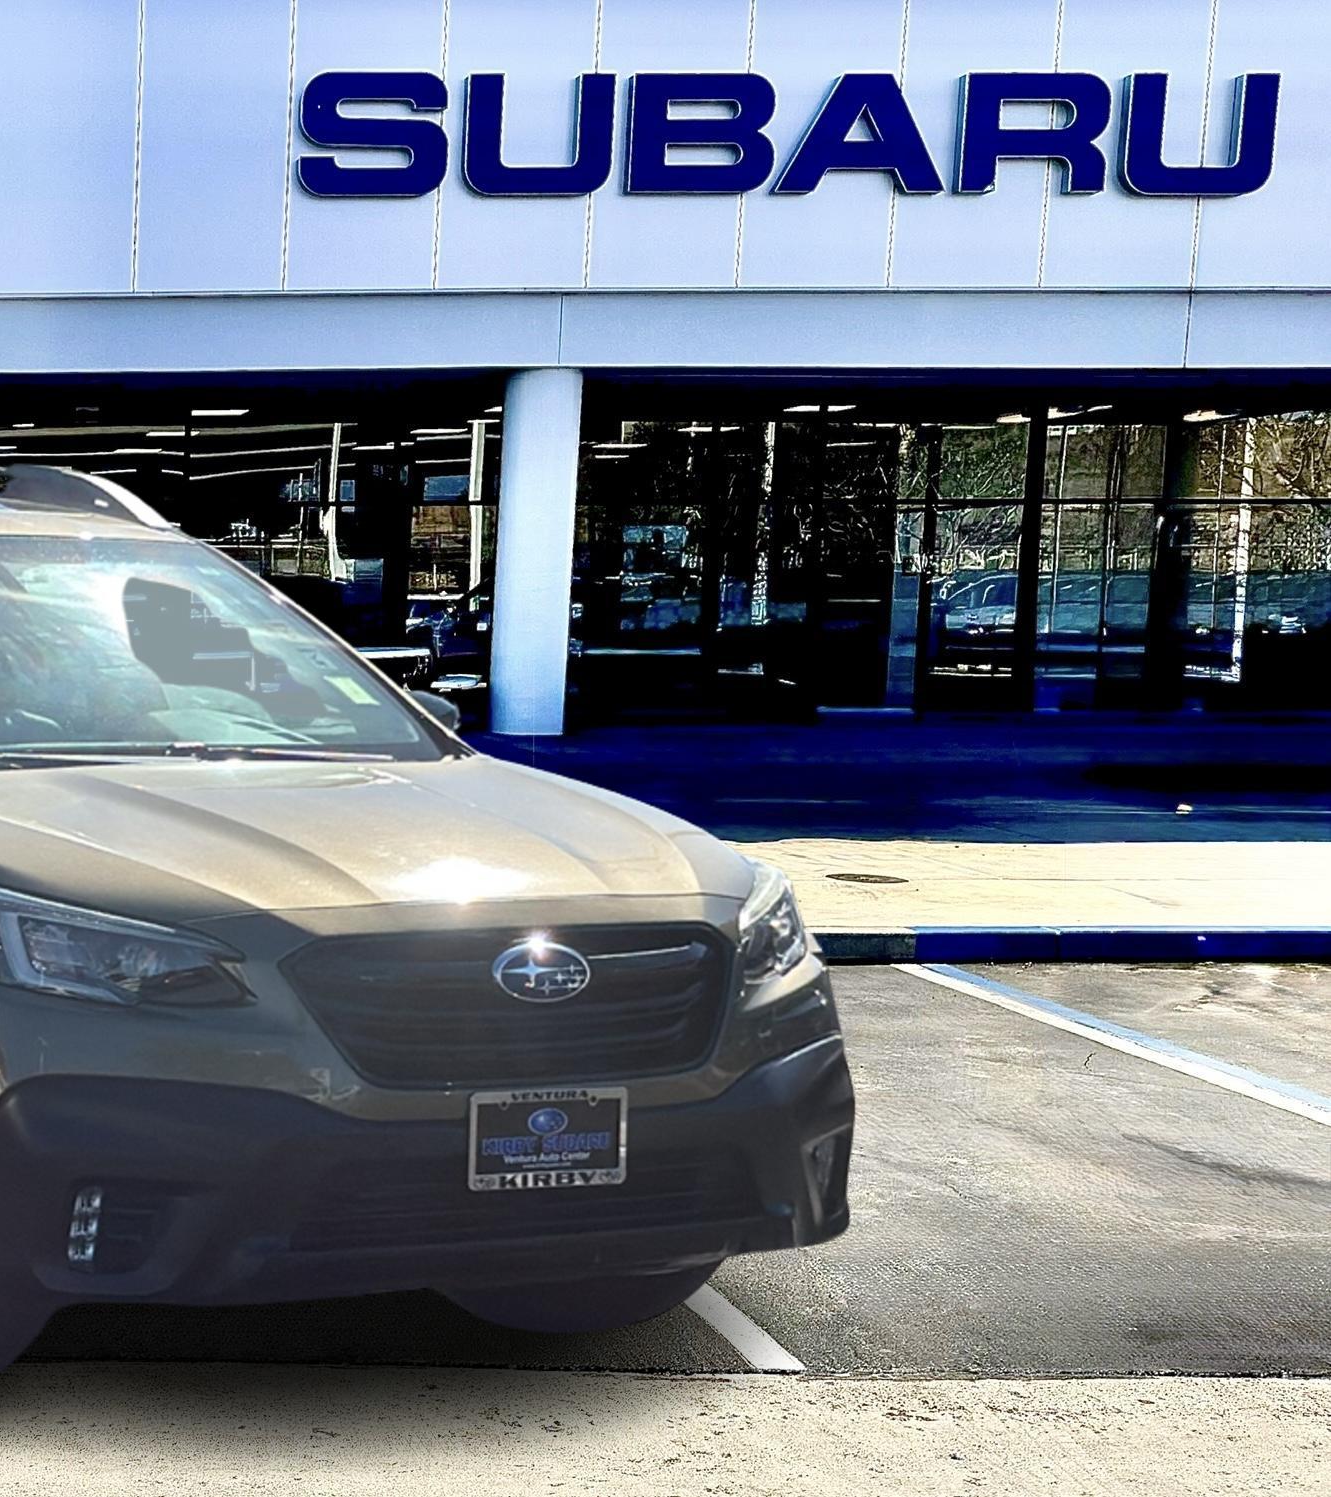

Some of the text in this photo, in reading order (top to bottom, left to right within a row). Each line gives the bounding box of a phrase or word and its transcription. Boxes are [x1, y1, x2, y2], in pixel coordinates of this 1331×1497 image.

[296, 71, 1281, 199] SUBARU
[511, 1090, 589, 1101] VENTURA
[483, 1132, 610, 1155] KIRBY SUBARU
[504, 1151, 590, 1164] Ventura Auto Center
[499, 1172, 597, 1188] KIRBY
